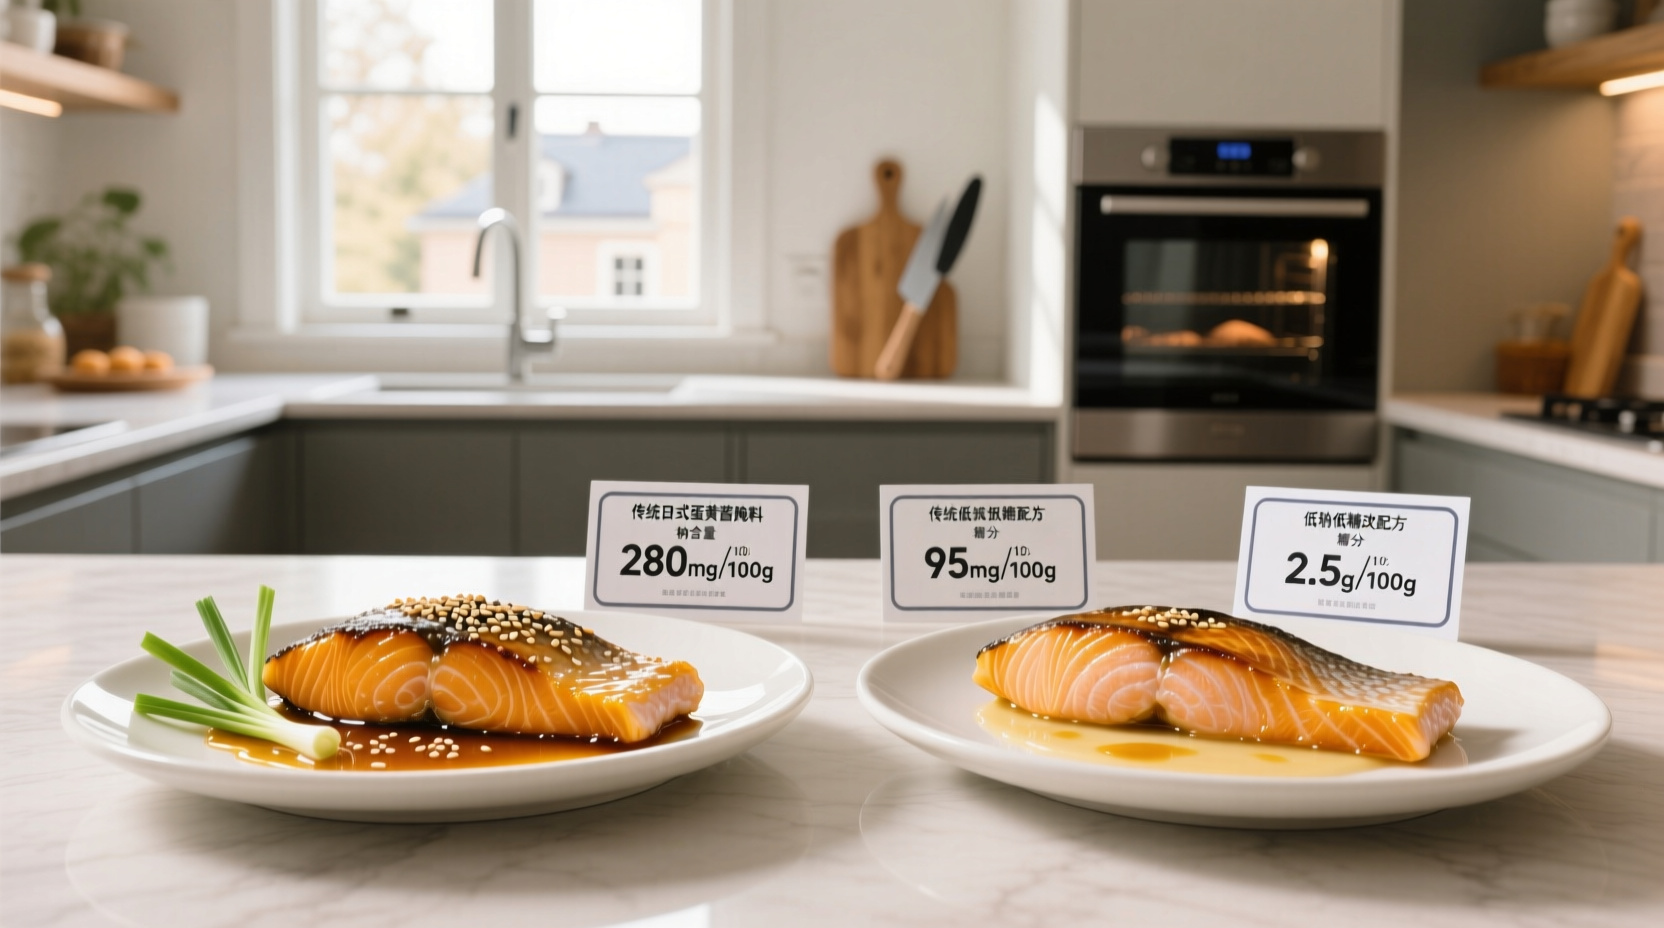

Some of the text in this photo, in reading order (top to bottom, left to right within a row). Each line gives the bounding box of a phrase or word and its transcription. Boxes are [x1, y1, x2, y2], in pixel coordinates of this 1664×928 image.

[620, 544, 773, 583] 280mg/100g
[925, 546, 1056, 583] 95mg/100g
[1285, 552, 1416, 597] 2.5g/100g
